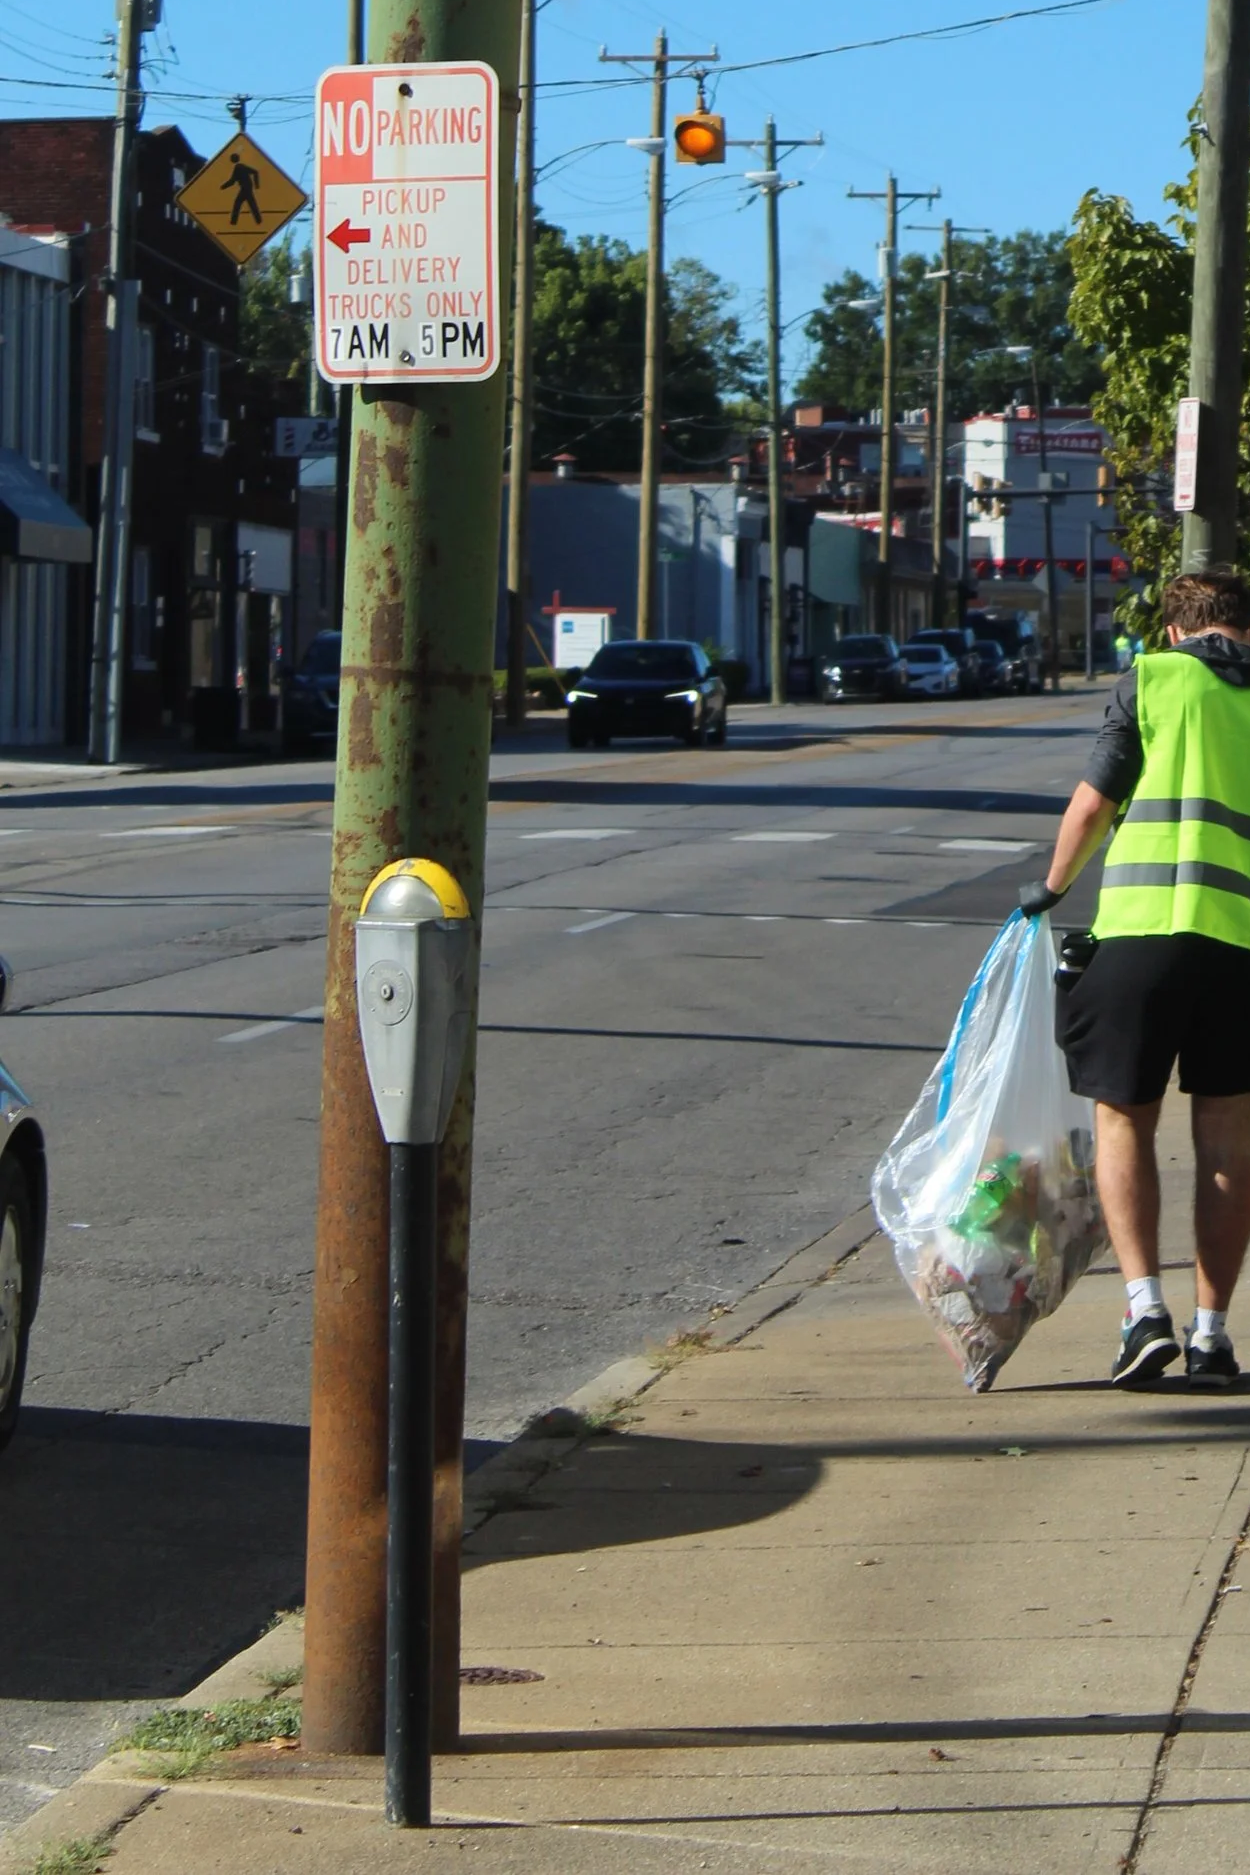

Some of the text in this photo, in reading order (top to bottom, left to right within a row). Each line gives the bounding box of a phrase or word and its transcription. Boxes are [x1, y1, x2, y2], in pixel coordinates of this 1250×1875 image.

[322, 99, 483, 158] NO PARKING
[362, 187, 446, 216] PICKUP
[380, 223, 427, 250] AND
[347, 256, 462, 286] DELIVERY
[328, 290, 484, 320] TRUCKS ONLY
[330, 321, 485, 360] 7AM 5PM
